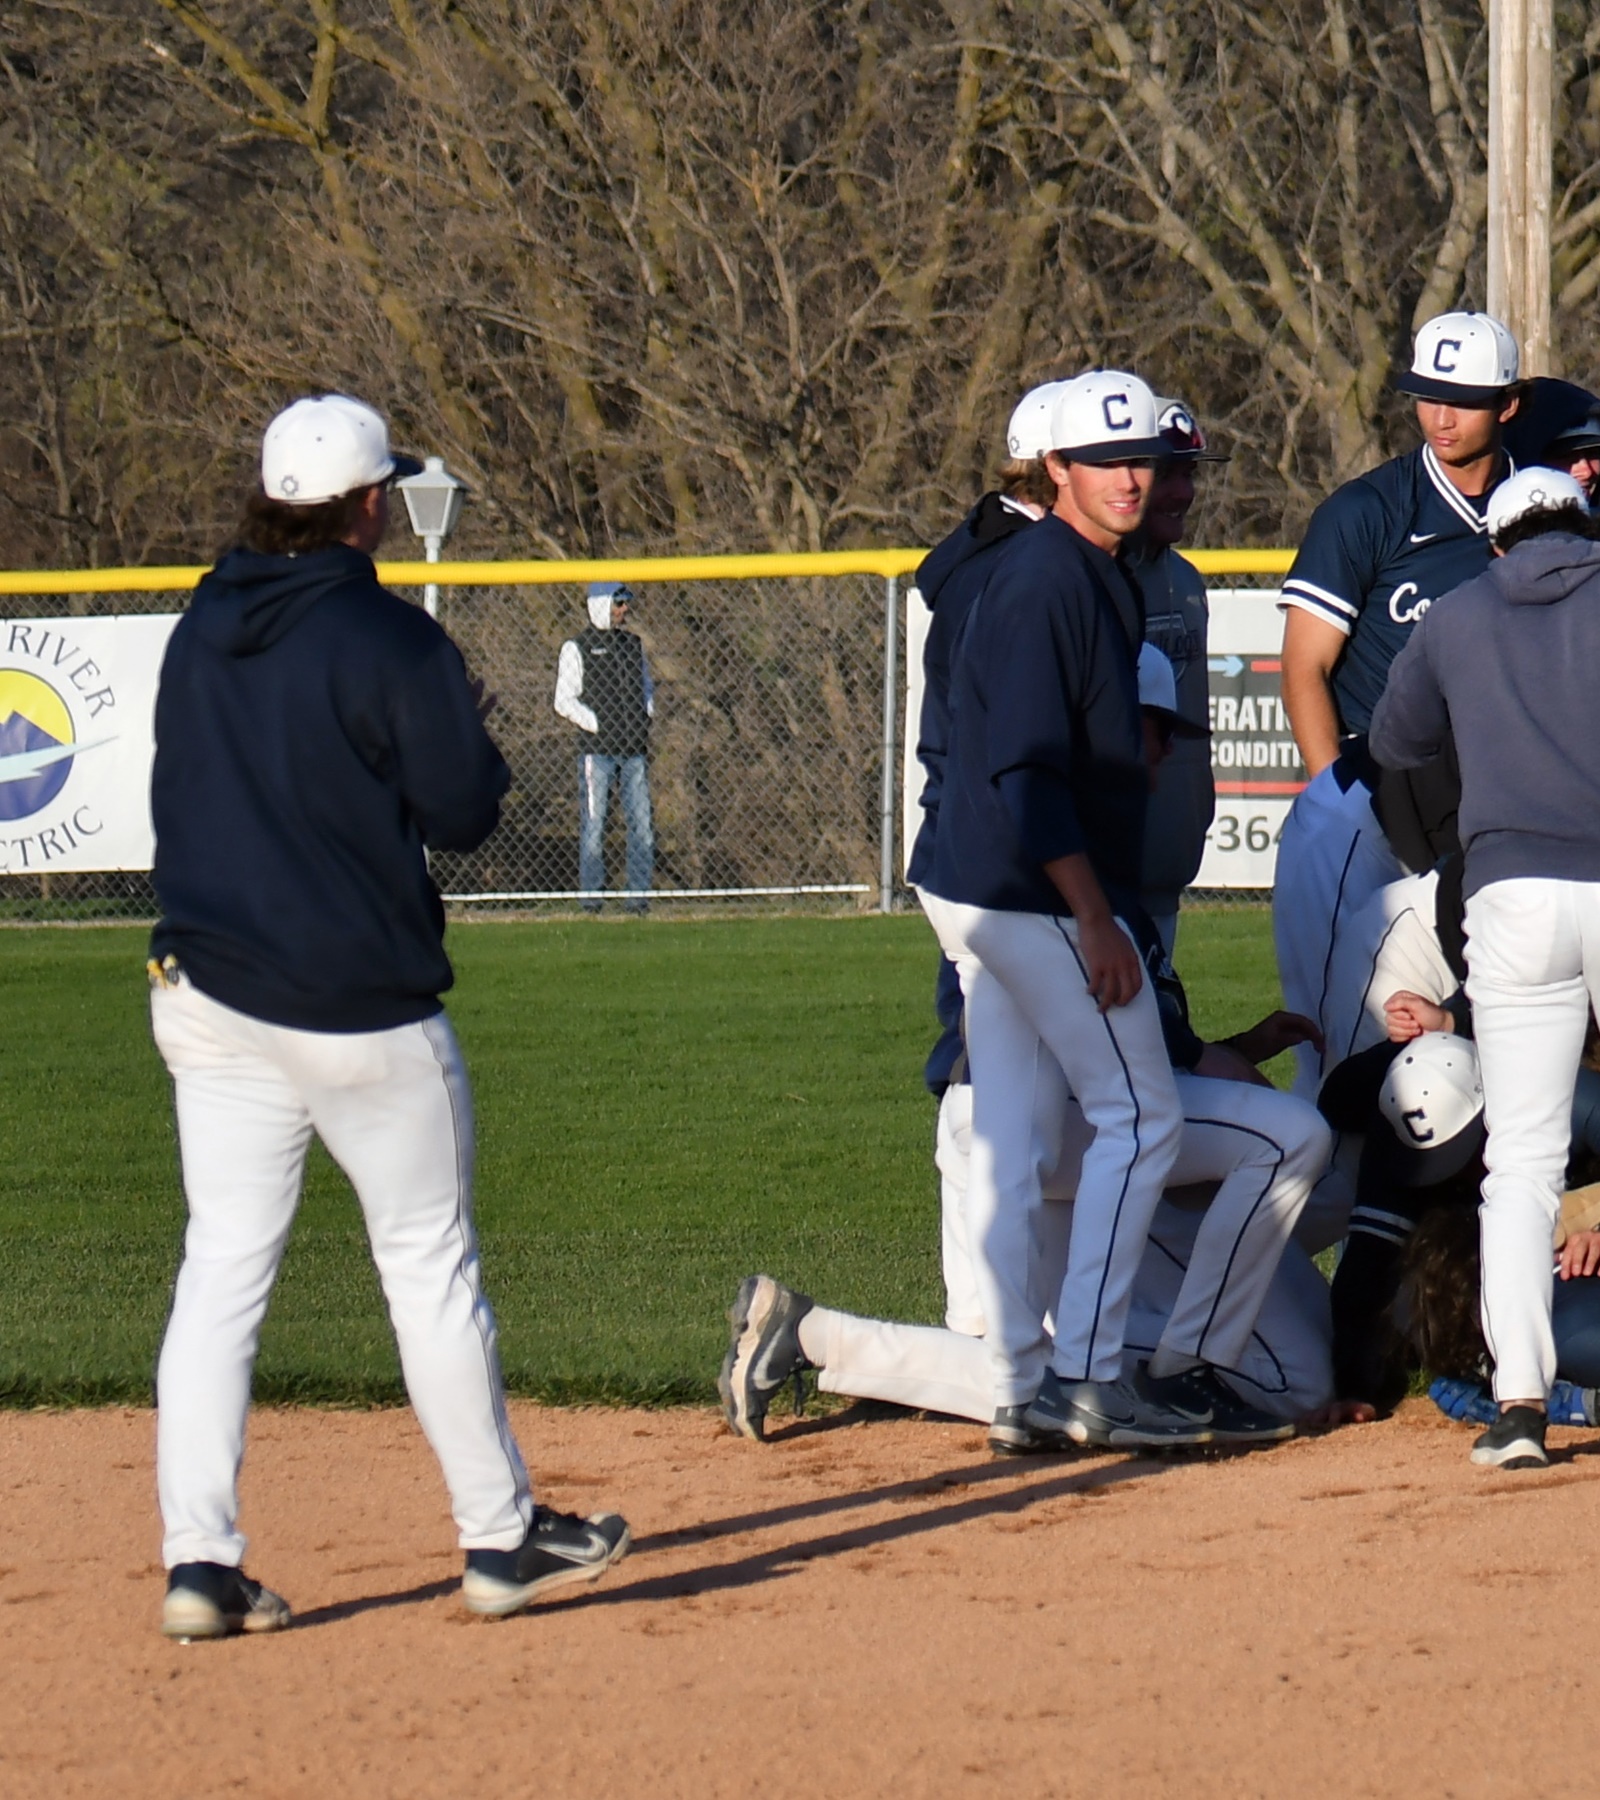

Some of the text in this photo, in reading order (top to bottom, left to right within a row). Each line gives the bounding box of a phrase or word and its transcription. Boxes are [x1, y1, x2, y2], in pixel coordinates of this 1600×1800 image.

[1433, 338, 1463, 374] C
[1102, 393, 1133, 431] C
[6, 624, 116, 719] RIVER
[1208, 695, 1292, 732] ERATI
[0, 804, 104, 870] TRIC
[1401, 1105, 1435, 1144] C
